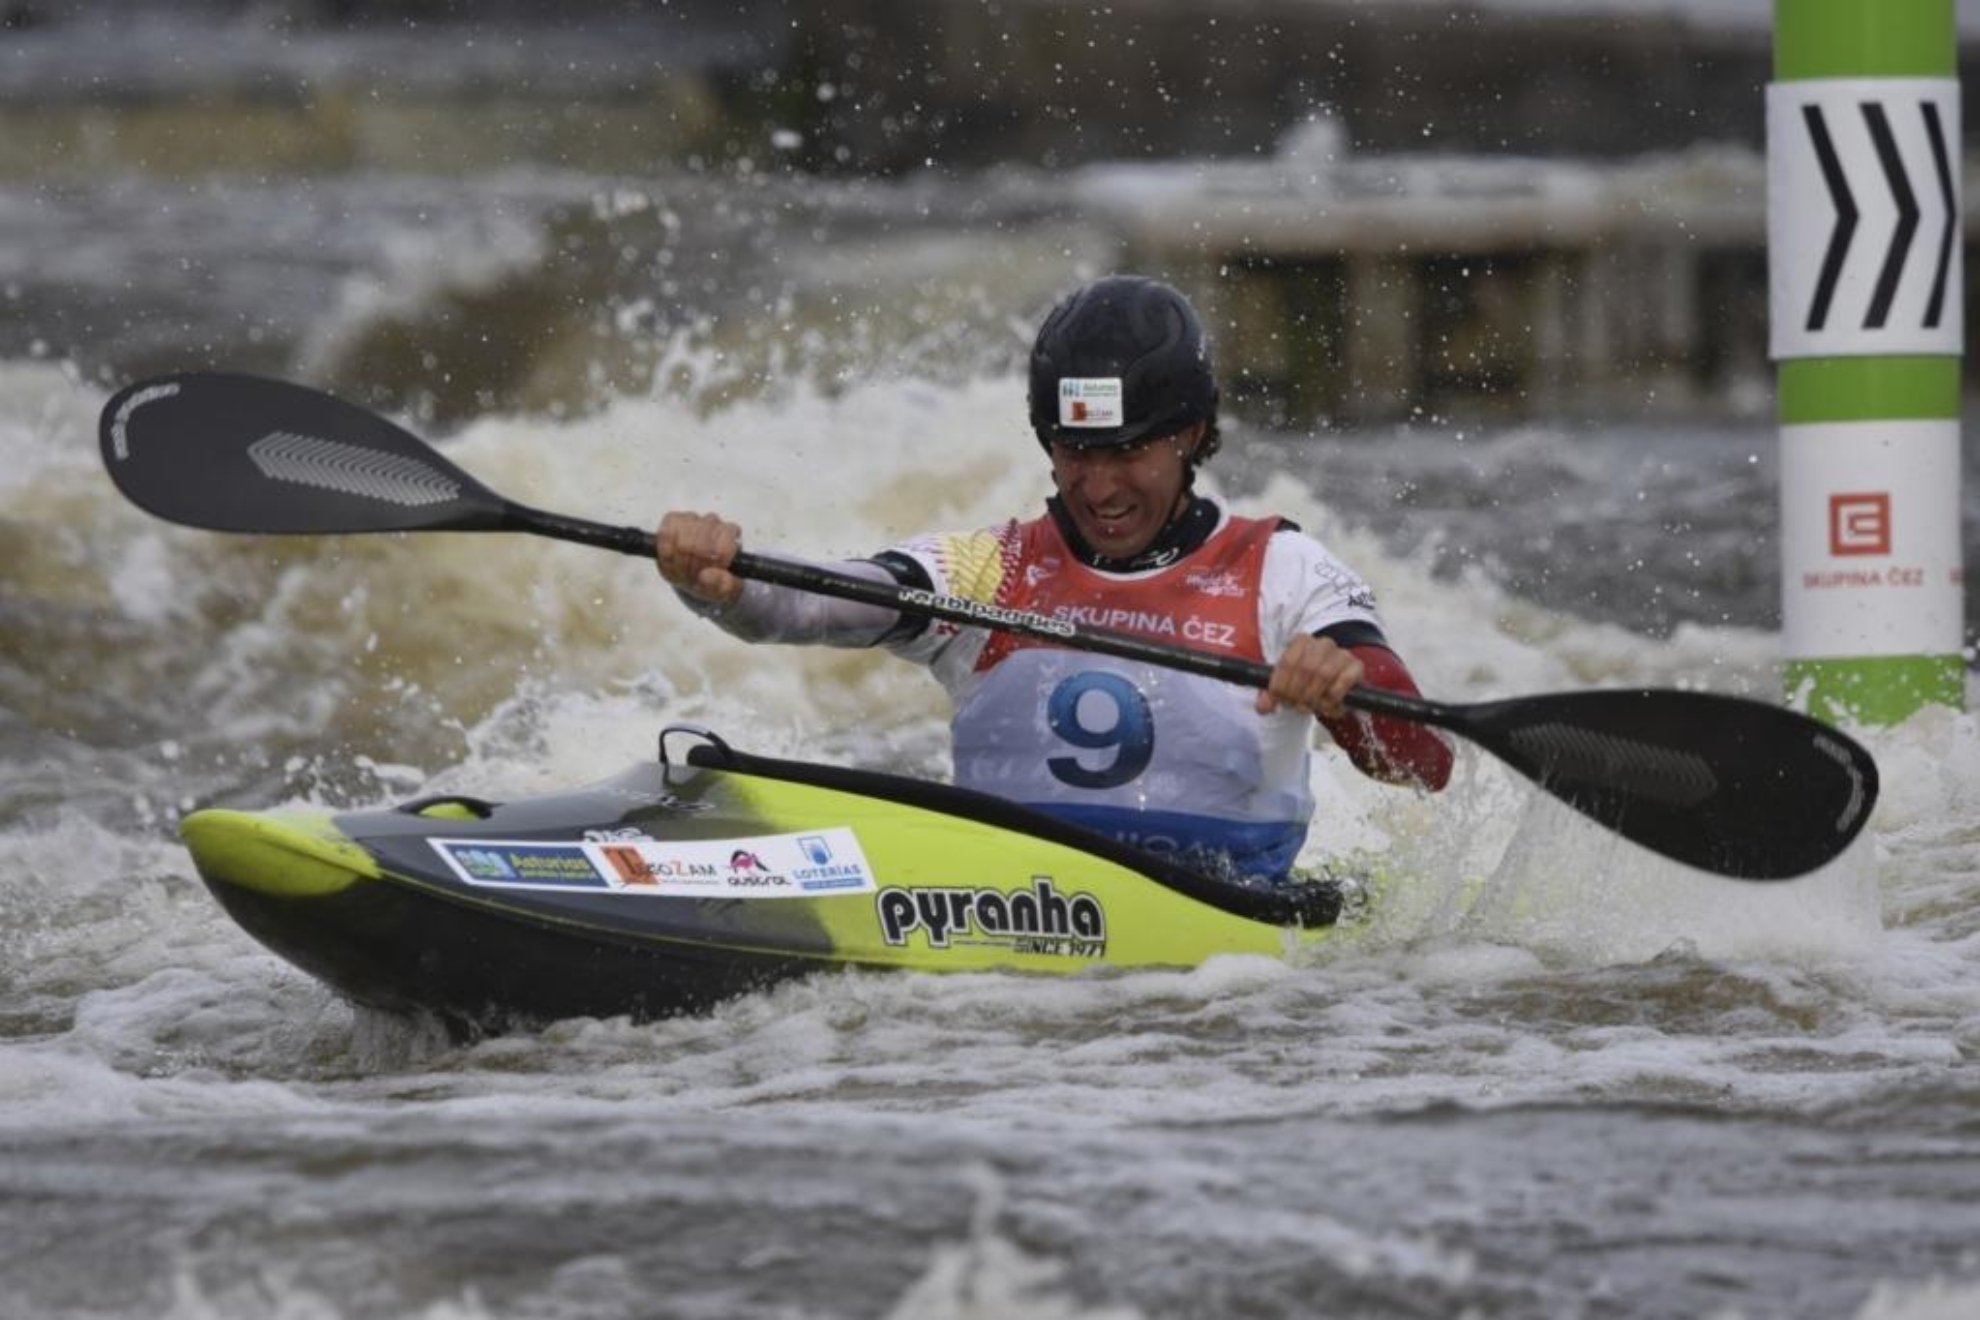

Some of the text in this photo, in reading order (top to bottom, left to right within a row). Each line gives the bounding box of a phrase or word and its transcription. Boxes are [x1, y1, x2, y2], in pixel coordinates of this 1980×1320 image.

[1803, 567, 1924, 590] SKUPINA ČEZ
[1053, 604, 1238, 648] SKUPINA ČEZ
[1046, 669, 1155, 790] 9
[877, 876, 1106, 946] pyranha
